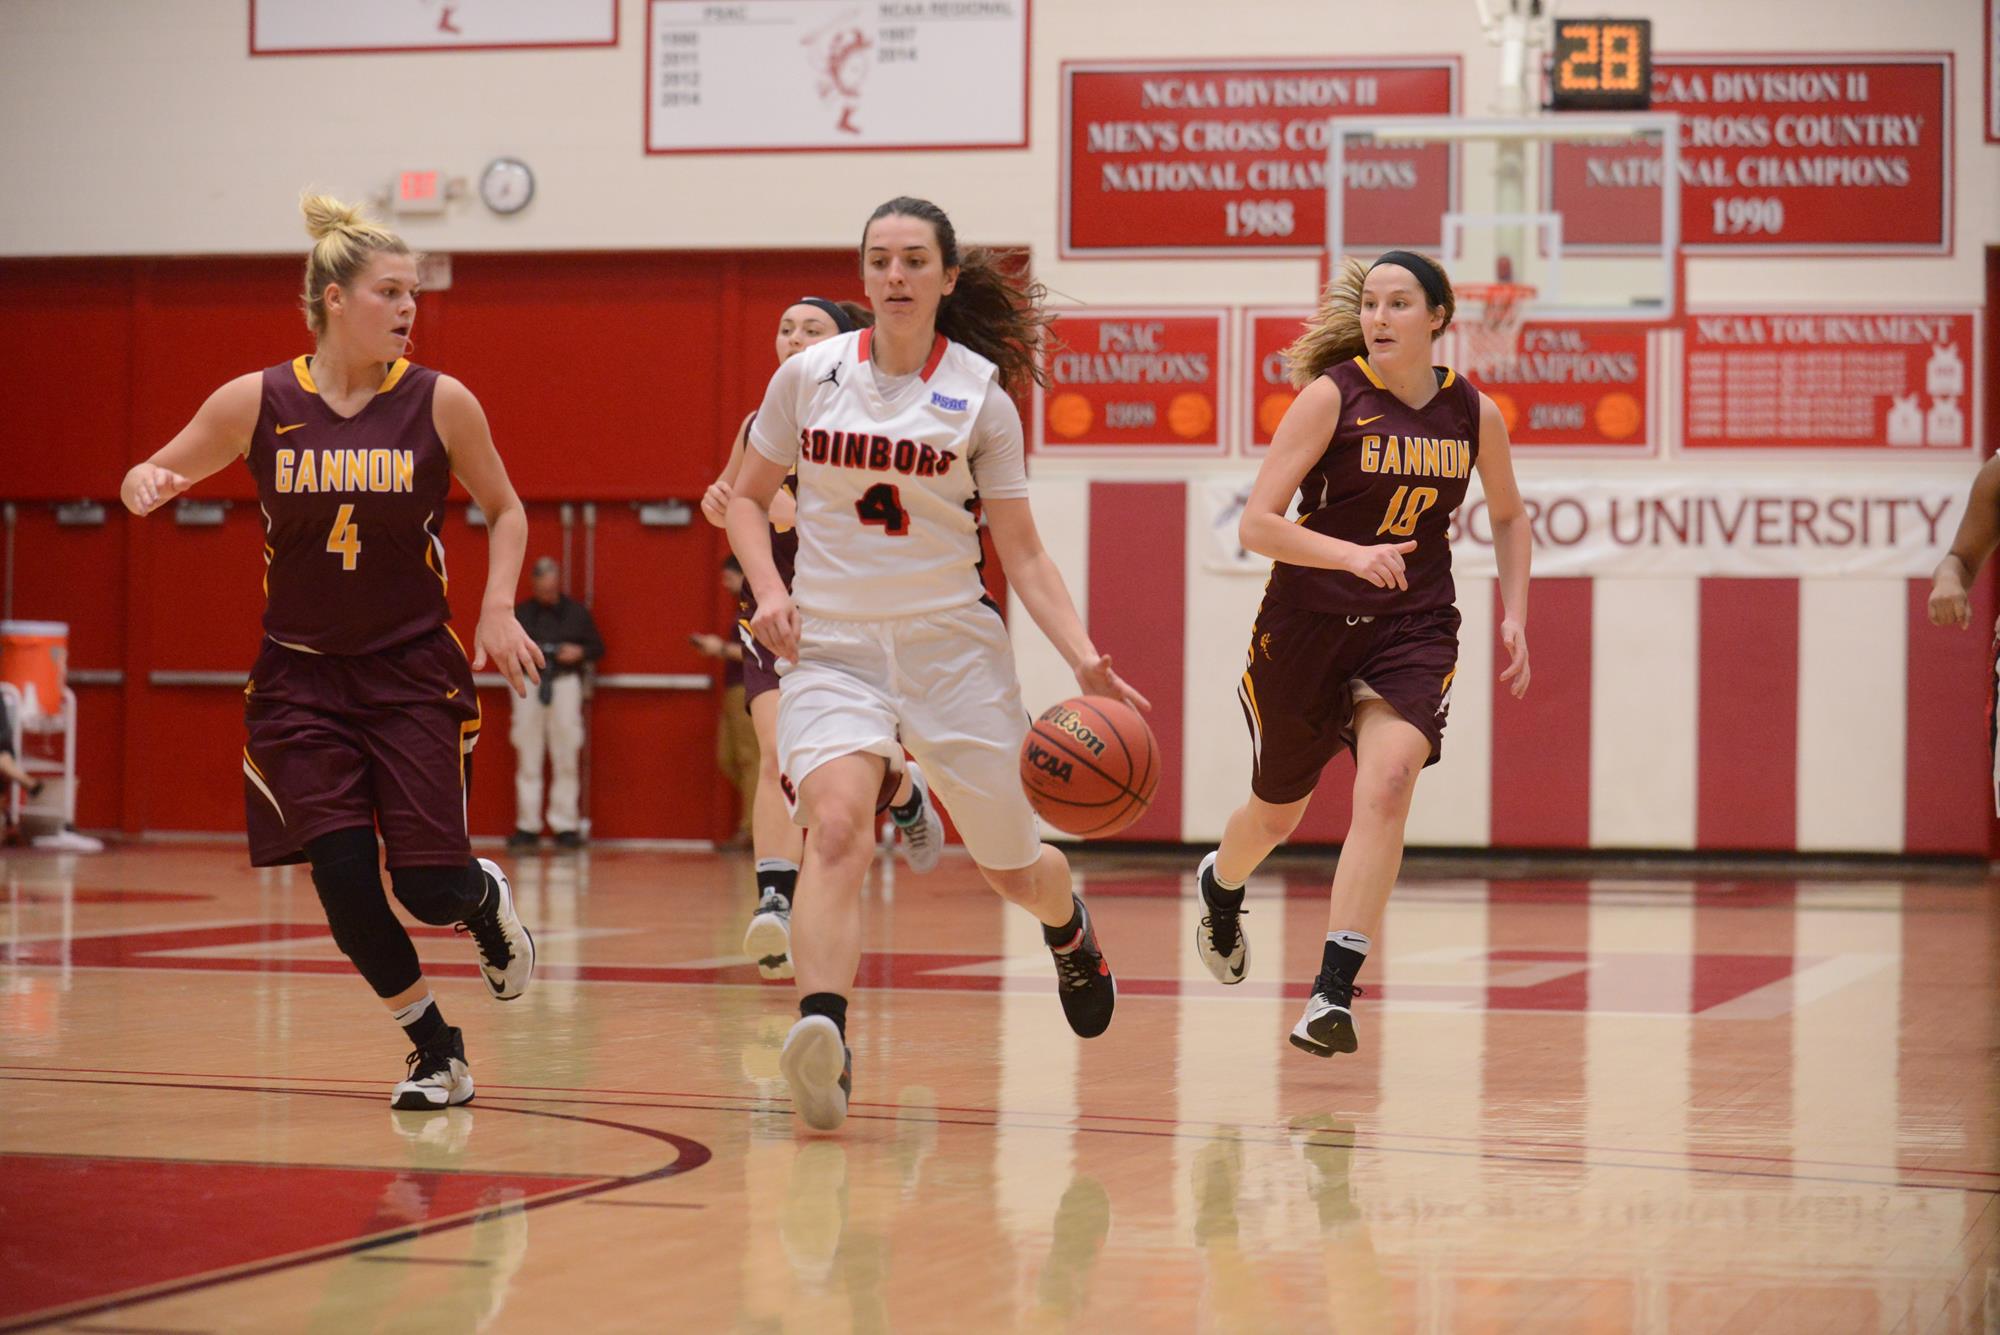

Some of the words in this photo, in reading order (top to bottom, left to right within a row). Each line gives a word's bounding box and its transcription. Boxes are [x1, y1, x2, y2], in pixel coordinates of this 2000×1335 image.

[1560, 24, 1642, 92] 28
[1142, 80, 1221, 108] NCAA
[1225, 77, 1351, 107] DIVISION
[1355, 77, 1378, 106] II
[1651, 72, 1708, 103] CAA
[1712, 71, 1842, 102] DIVISION
[1846, 72, 1869, 101] II
[1087, 121, 1178, 153] MEN'S
[1183, 121, 1281, 151] CROSS
[1775, 114, 1925, 147] COUNTRY
[1102, 162, 1244, 192] NATIONAL
[1736, 156, 1910, 187] CHAMPIONS
[1225, 199, 1295, 237] 1988
[1712, 197, 1784, 235] 1990
[1099, 322, 1165, 353] PSAC
[1696, 318, 1766, 344] NCAA
[1769, 317, 1955, 344] TOURNAMENT
[1053, 352, 1209, 384] CHAMPIONS
[275, 448, 414, 493] GANNON
[1361, 435, 1470, 479] GANNON
[854, 482, 910, 537] 4
[1376, 485, 1438, 537] 10
[1608, 496, 1952, 548] UNIVERSITY
[326, 504, 361, 570] 4
[1039, 704, 1106, 757] Wilson
[1026, 741, 1073, 784] NCAA
